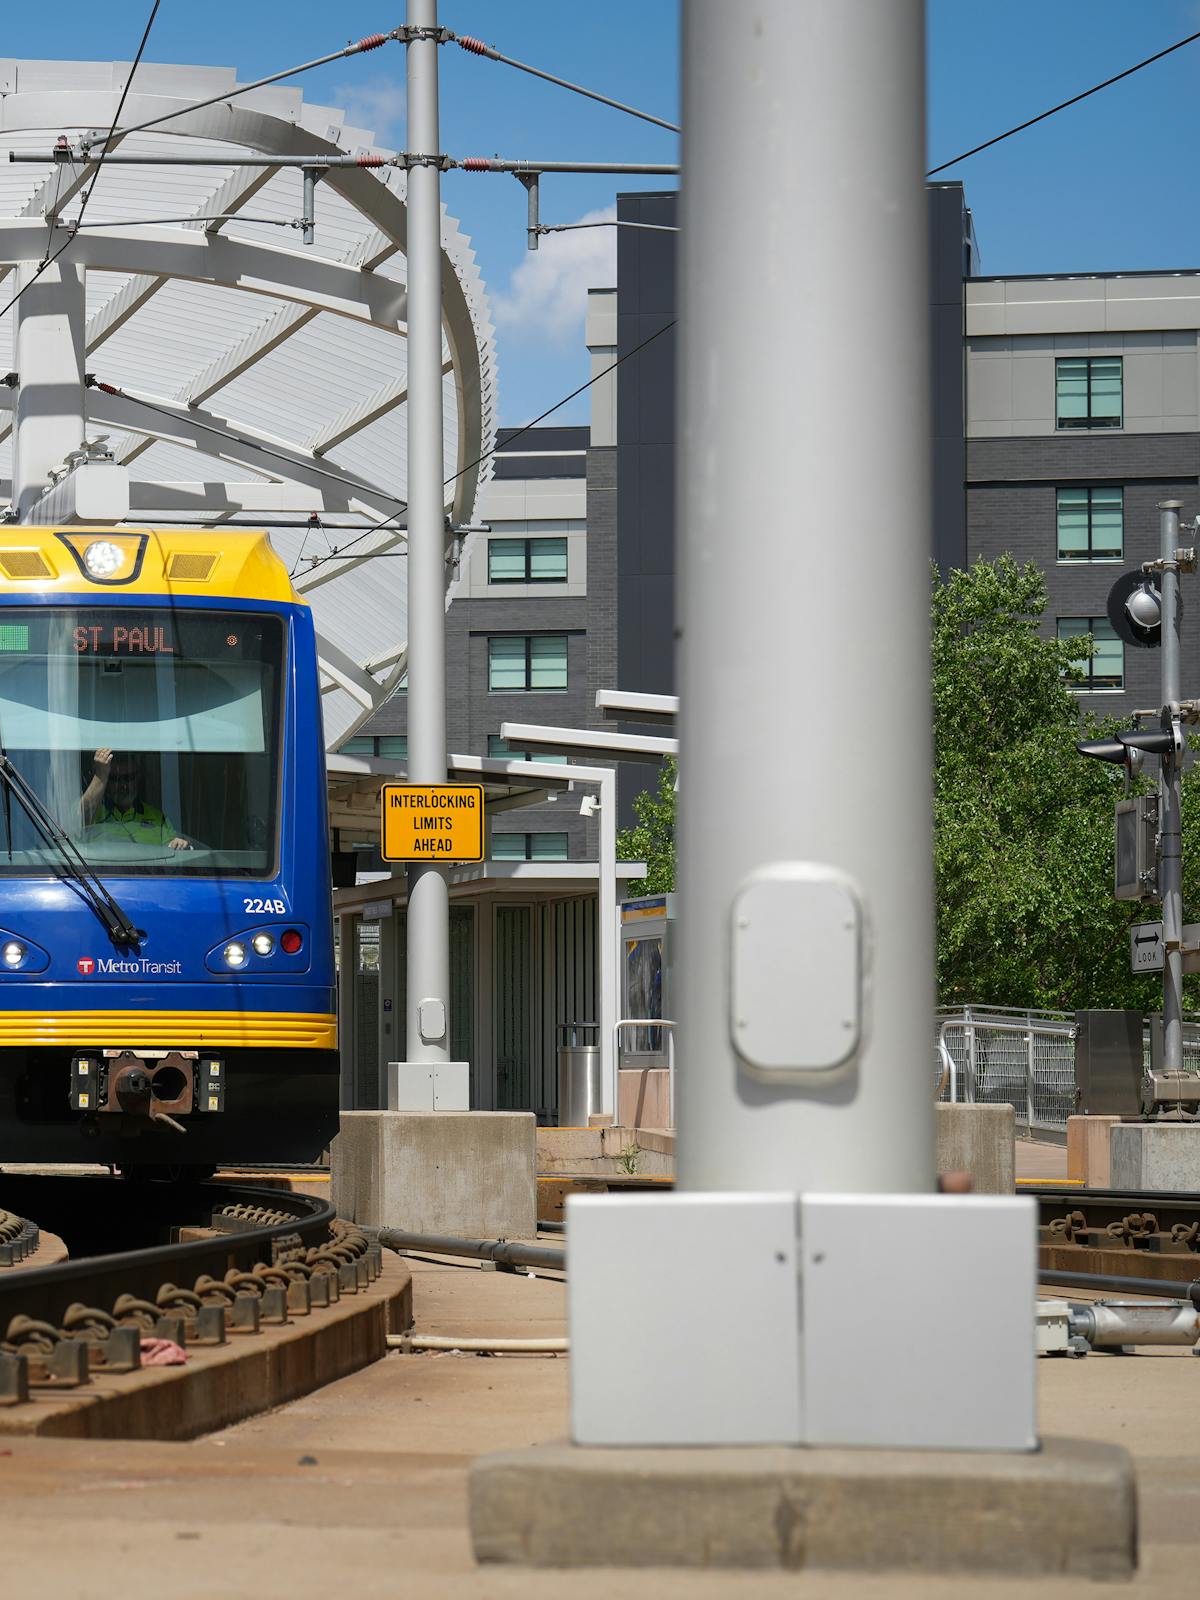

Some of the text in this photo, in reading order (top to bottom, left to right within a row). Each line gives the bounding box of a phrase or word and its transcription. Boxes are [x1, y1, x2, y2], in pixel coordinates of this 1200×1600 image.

[73, 626, 174, 652] ST PAUL
[391, 795, 475, 808] INTERLOCKING
[413, 816, 453, 830] LIMITS
[413, 838, 452, 852] AHEAD
[243, 898, 286, 914] 224B
[1138, 952, 1157, 964] LOOK
